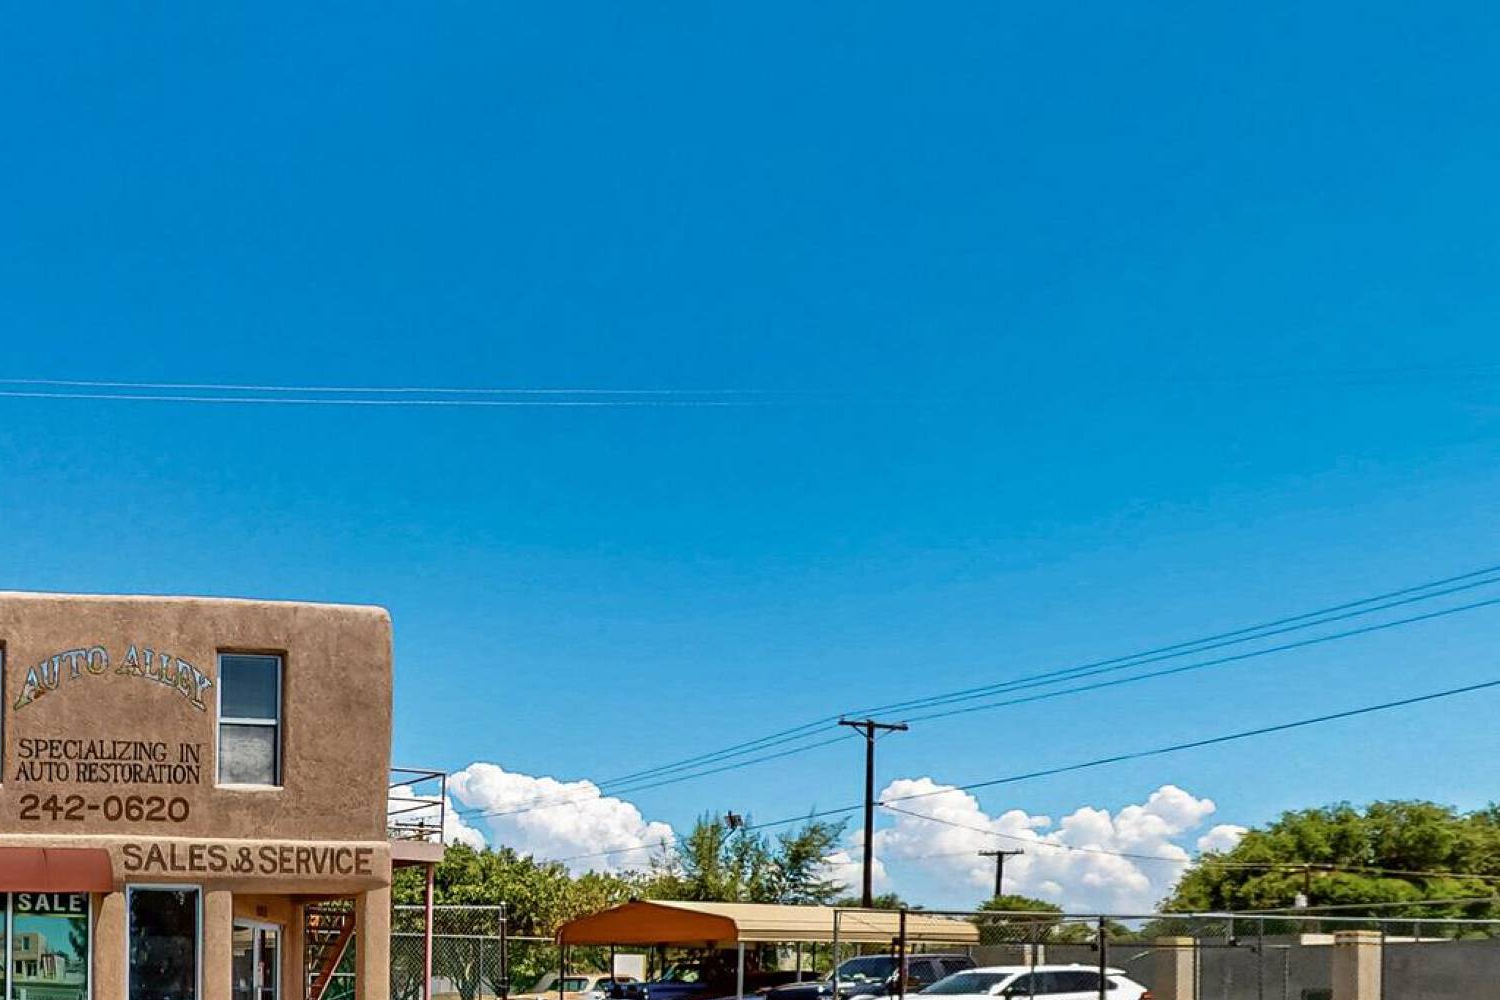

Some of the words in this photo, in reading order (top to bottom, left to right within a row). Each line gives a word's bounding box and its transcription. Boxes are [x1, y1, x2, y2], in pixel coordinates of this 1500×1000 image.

[13, 645, 108, 710] AUTO
[115, 645, 212, 712] ALLEY
[18, 738, 167, 762] SPECIALIZING
[179, 743, 200, 763] IN
[15, 761, 69, 782] AUTO
[75, 762, 200, 784] RESTORATION
[19, 793, 190, 822] 242-0620
[122, 843, 227, 873] SALES
[258, 846, 373, 875] SERVICE
[18, 893, 81, 911] SALE
